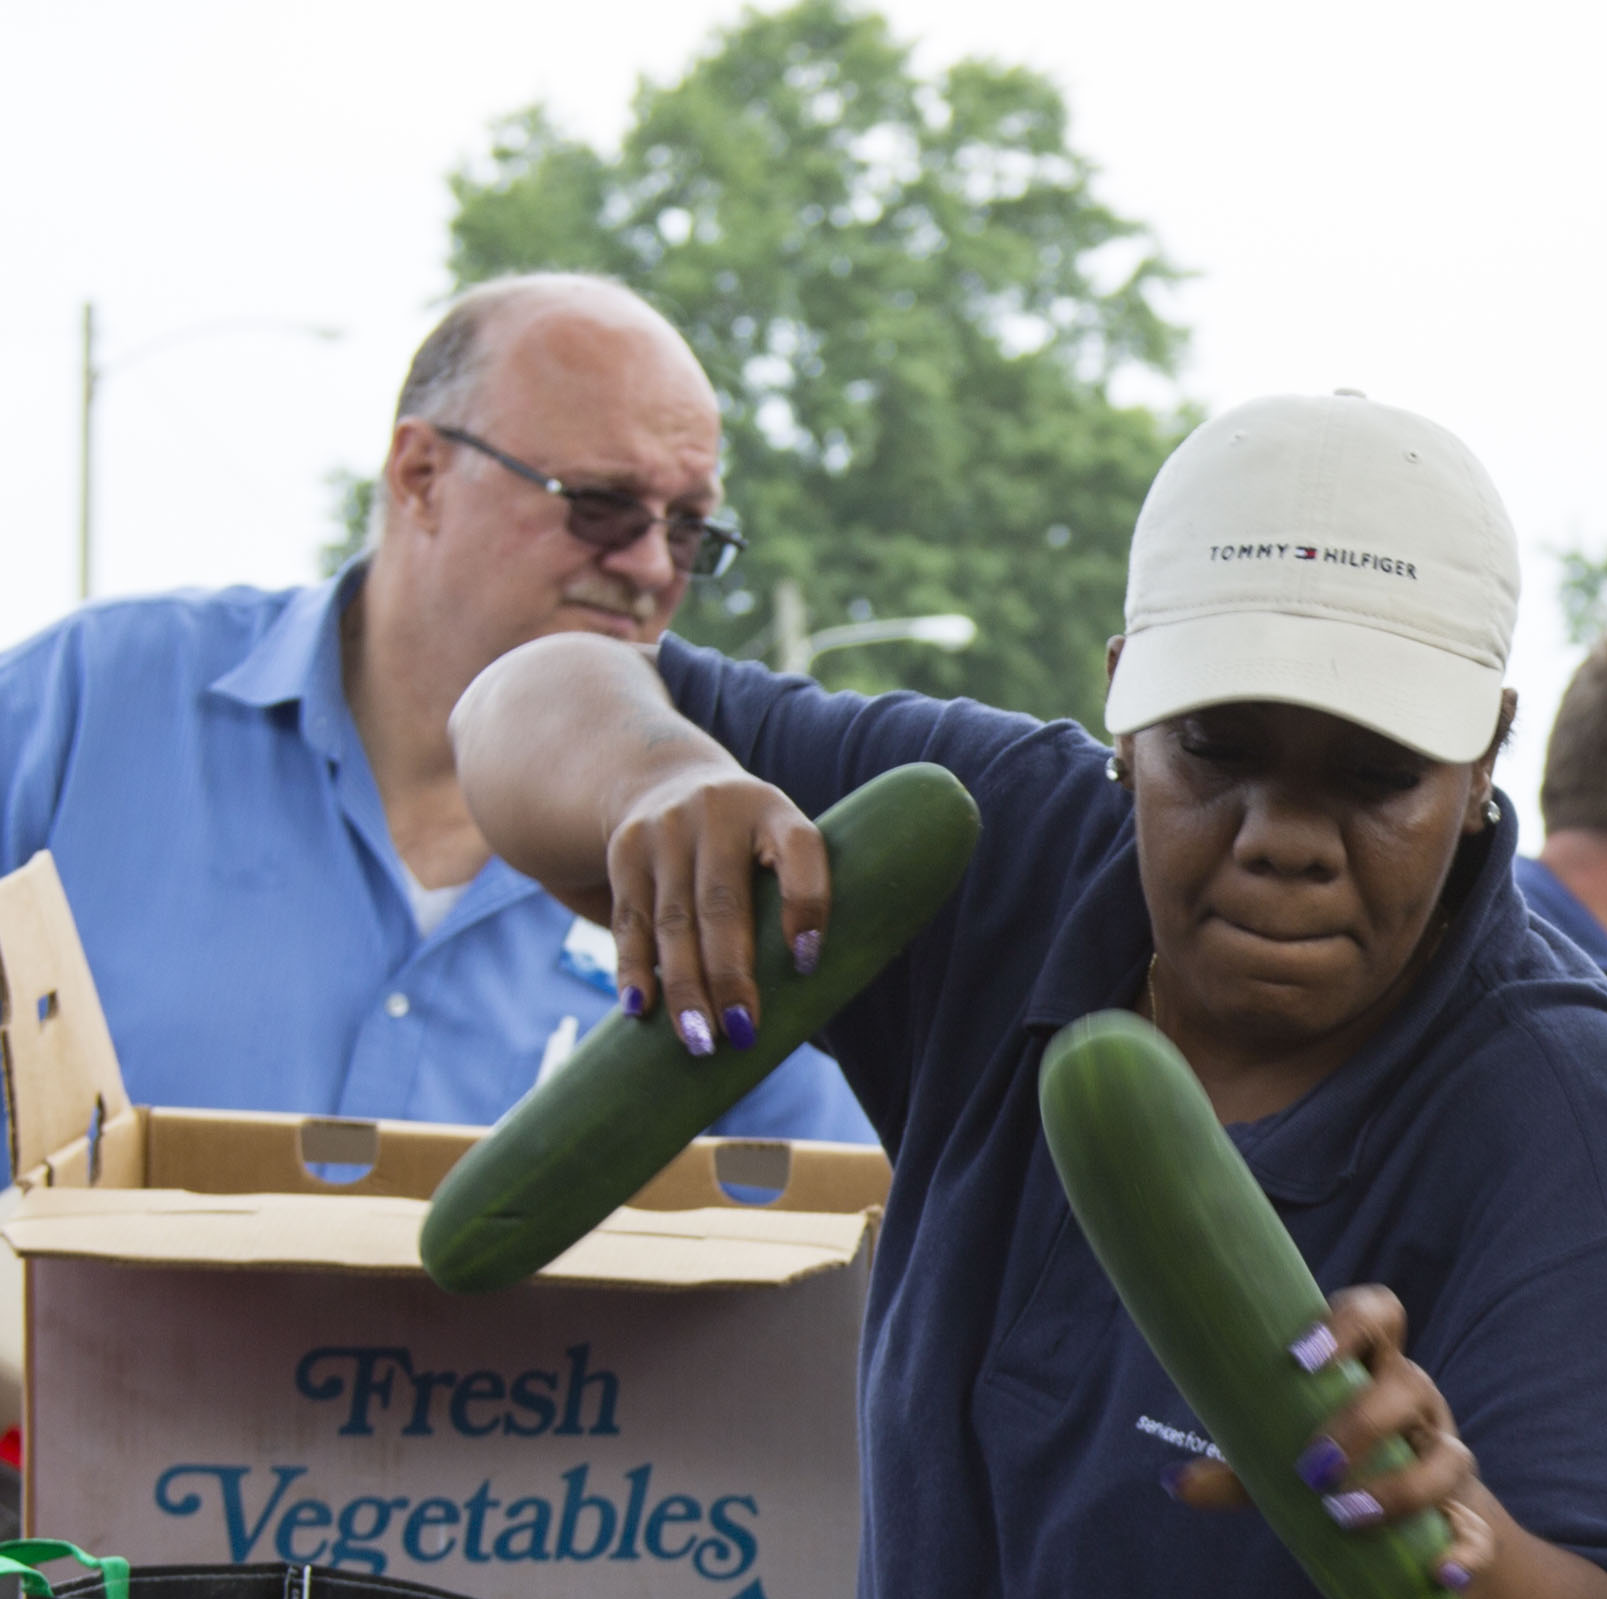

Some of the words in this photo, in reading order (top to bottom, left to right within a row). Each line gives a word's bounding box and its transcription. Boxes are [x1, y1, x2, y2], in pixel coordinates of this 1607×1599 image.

[1210, 543, 1288, 560] TOMMY
[1324, 547, 1417, 579] HILFIGER
[296, 1343, 621, 1437] Fresh
[154, 1463, 760, 1581] Vegetables
